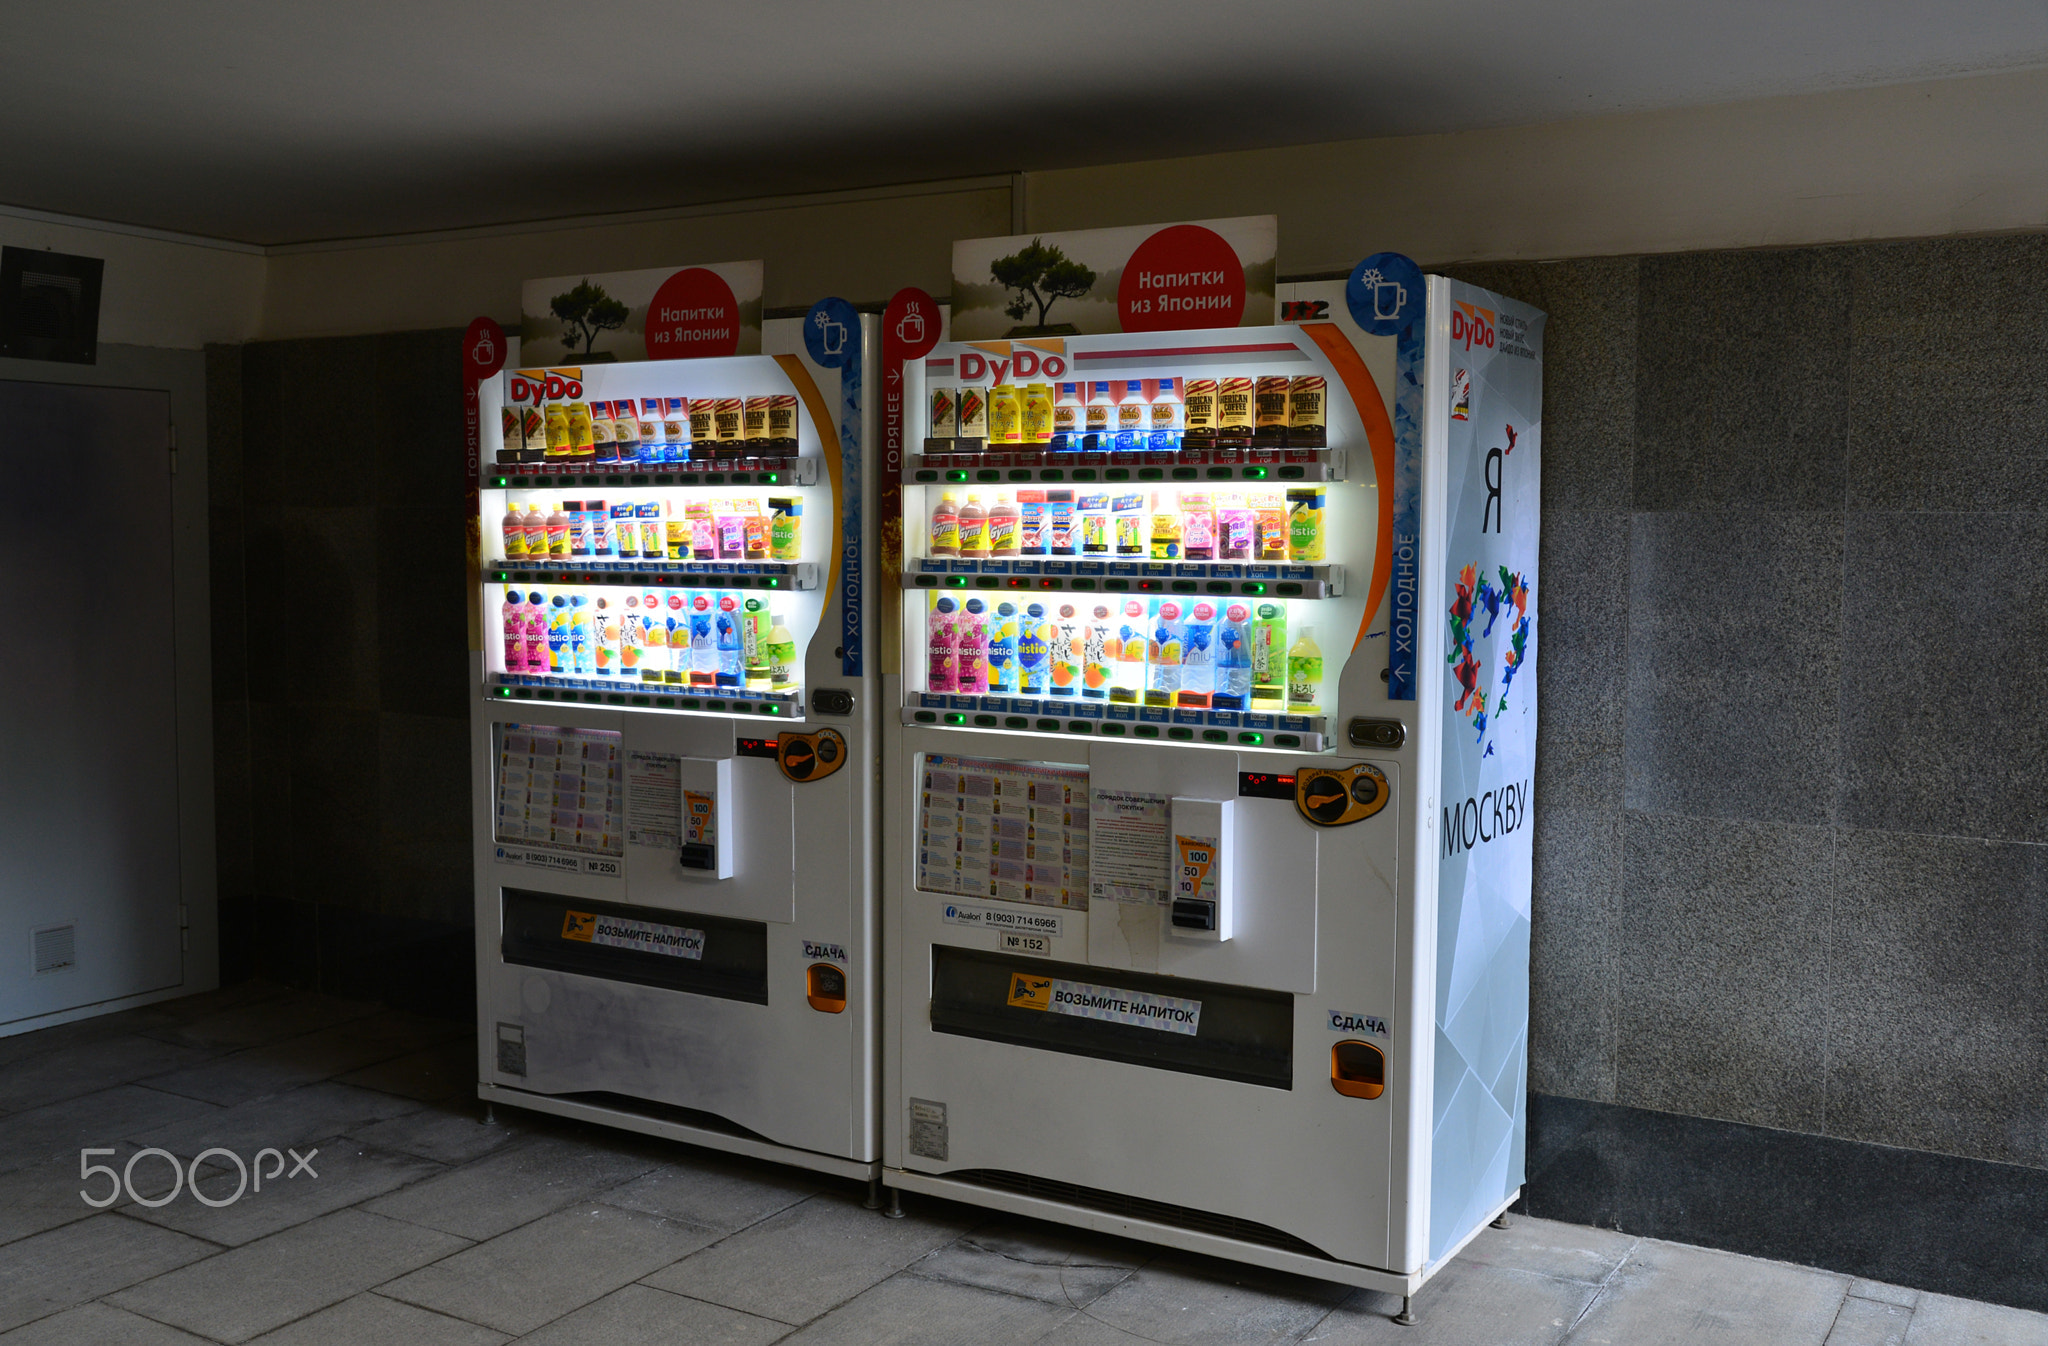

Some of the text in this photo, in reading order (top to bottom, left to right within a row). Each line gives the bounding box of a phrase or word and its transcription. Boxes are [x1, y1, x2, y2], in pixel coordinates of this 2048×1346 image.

[1139, 269, 1224, 289] Напитки
[1131, 292, 1232, 314] из Японии
[661, 307, 725, 323] Напитки
[655, 327, 730, 344] из Японии
[1453, 310, 1495, 351] DyDo
[960, 351, 1066, 388] DyDo
[511, 375, 583, 405] DyDo
[1290, 392, 1321, 402] MERICAN
[1185, 396, 1213, 405] MERICAN
[1219, 394, 1248, 404] MERICAN
[888, 392, 900, 473] ГОРЯЧЕЕ
[467, 407, 477, 477] ГОРЯЧЕЕ
[1482, 447, 1503, 533] Я
[932, 522, 957, 538] Gym
[959, 526, 982, 543] Gym
[989, 524, 1014, 541] Gym
[846, 535, 860, 637] ХОЛОДНОЕ
[1396, 533, 1416, 653] ХОЛОДНОЕ
[1097, 794, 1124, 802] ПОРЯДОК
[694, 804, 708, 813] 100
[690, 817, 701, 825] 50
[1442, 779, 1528, 859] МОСКВУ
[689, 830, 697, 838] 10
[531, 854, 548, 863] (903)
[549, 856, 560, 864] 714
[561, 858, 578, 867] 6966
[1190, 852, 1207, 862] 100
[588, 862, 598, 870] №
[600, 863, 616, 873] 250
[1184, 866, 1198, 876] 50
[1181, 881, 1192, 891] 10
[958, 911, 1057, 928] Avalon 8 (903) 714 6966
[597, 924, 700, 950] ВОЗЬМИТЕ НАПИТОК
[1007, 936, 1043, 950] № 152
[805, 945, 845, 959] СДАЧА
[1055, 990, 1194, 1024] ВОЗЬМИТЕ НАПИТОК
[1332, 1015, 1386, 1033] СДАЧА
